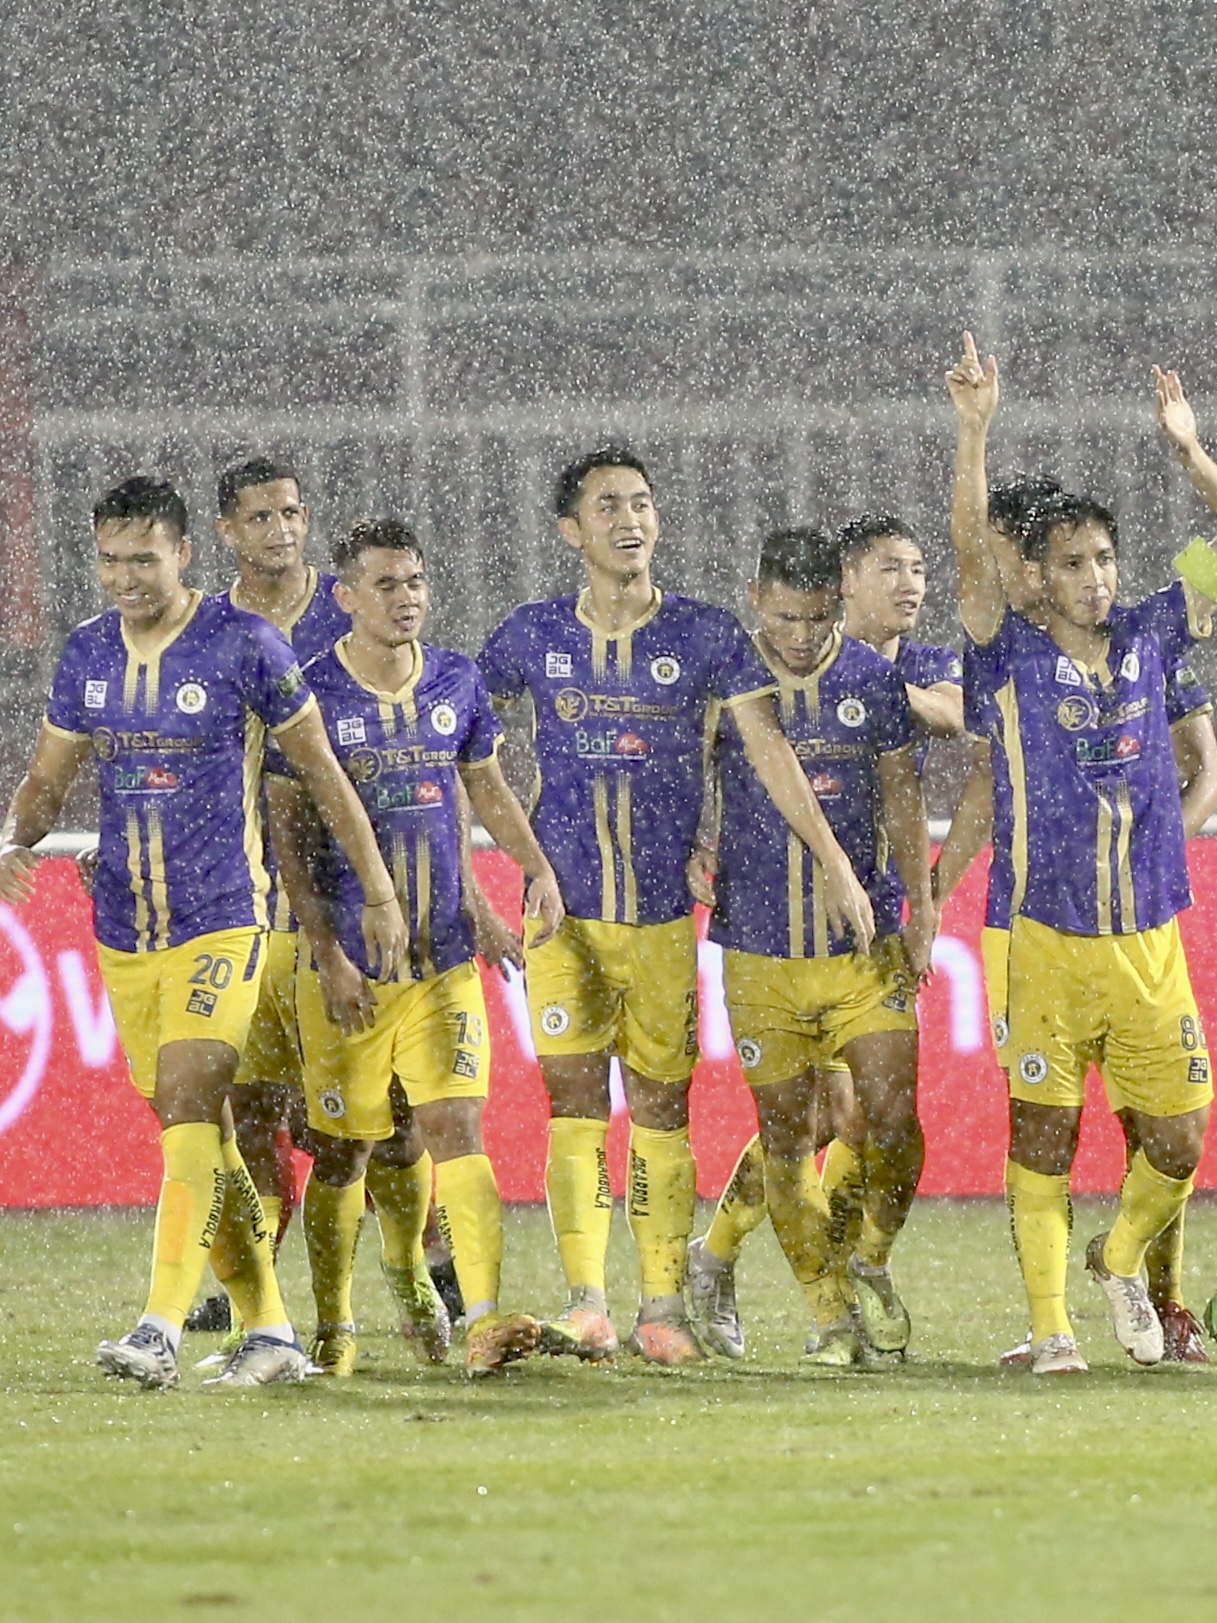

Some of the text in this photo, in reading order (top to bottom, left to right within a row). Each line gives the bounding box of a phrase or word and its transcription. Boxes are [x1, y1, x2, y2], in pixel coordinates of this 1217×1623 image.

[575, 729, 617, 754] BaF
[187, 953, 233, 990] 20
[198, 1167, 226, 1250] JOGARBOLA
